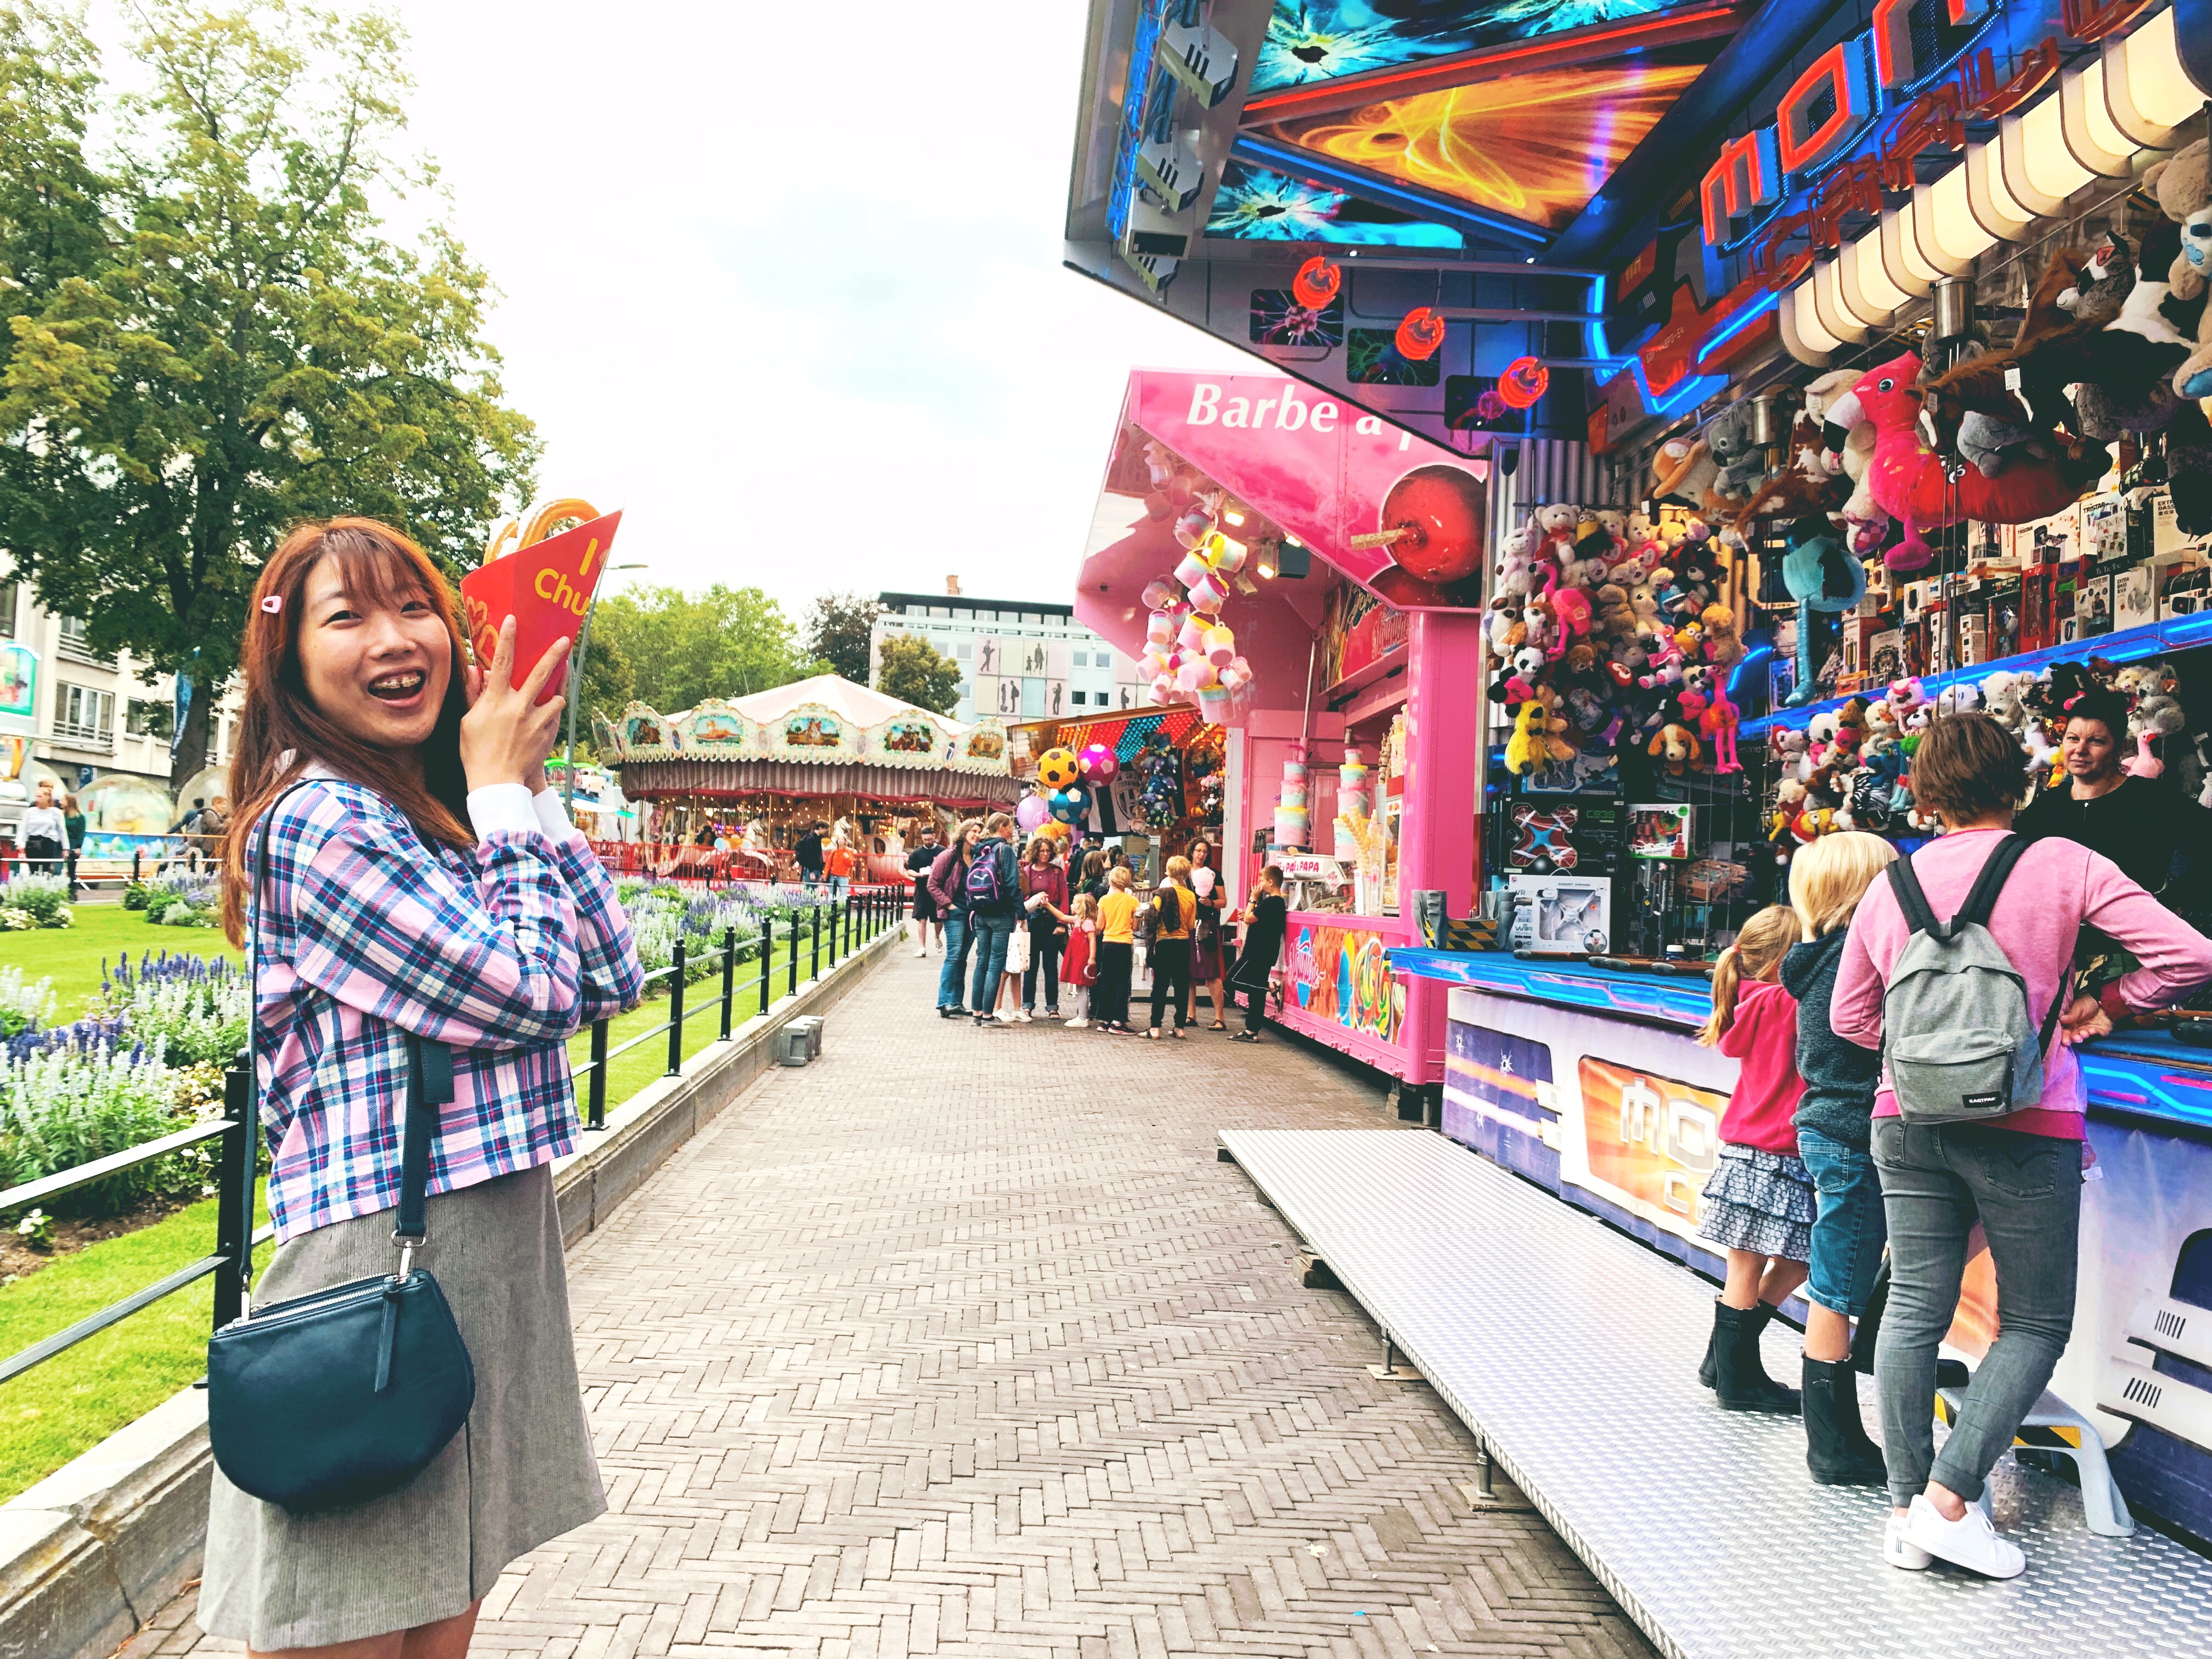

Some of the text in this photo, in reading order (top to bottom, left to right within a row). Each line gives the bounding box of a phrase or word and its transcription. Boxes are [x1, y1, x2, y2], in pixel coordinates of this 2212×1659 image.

[1186, 383, 1339, 433] Barbe
[2083, 501, 2105, 514] TRISTAR
[579, 538, 598, 575] I
[1300, 861, 1319, 872] PAPA
